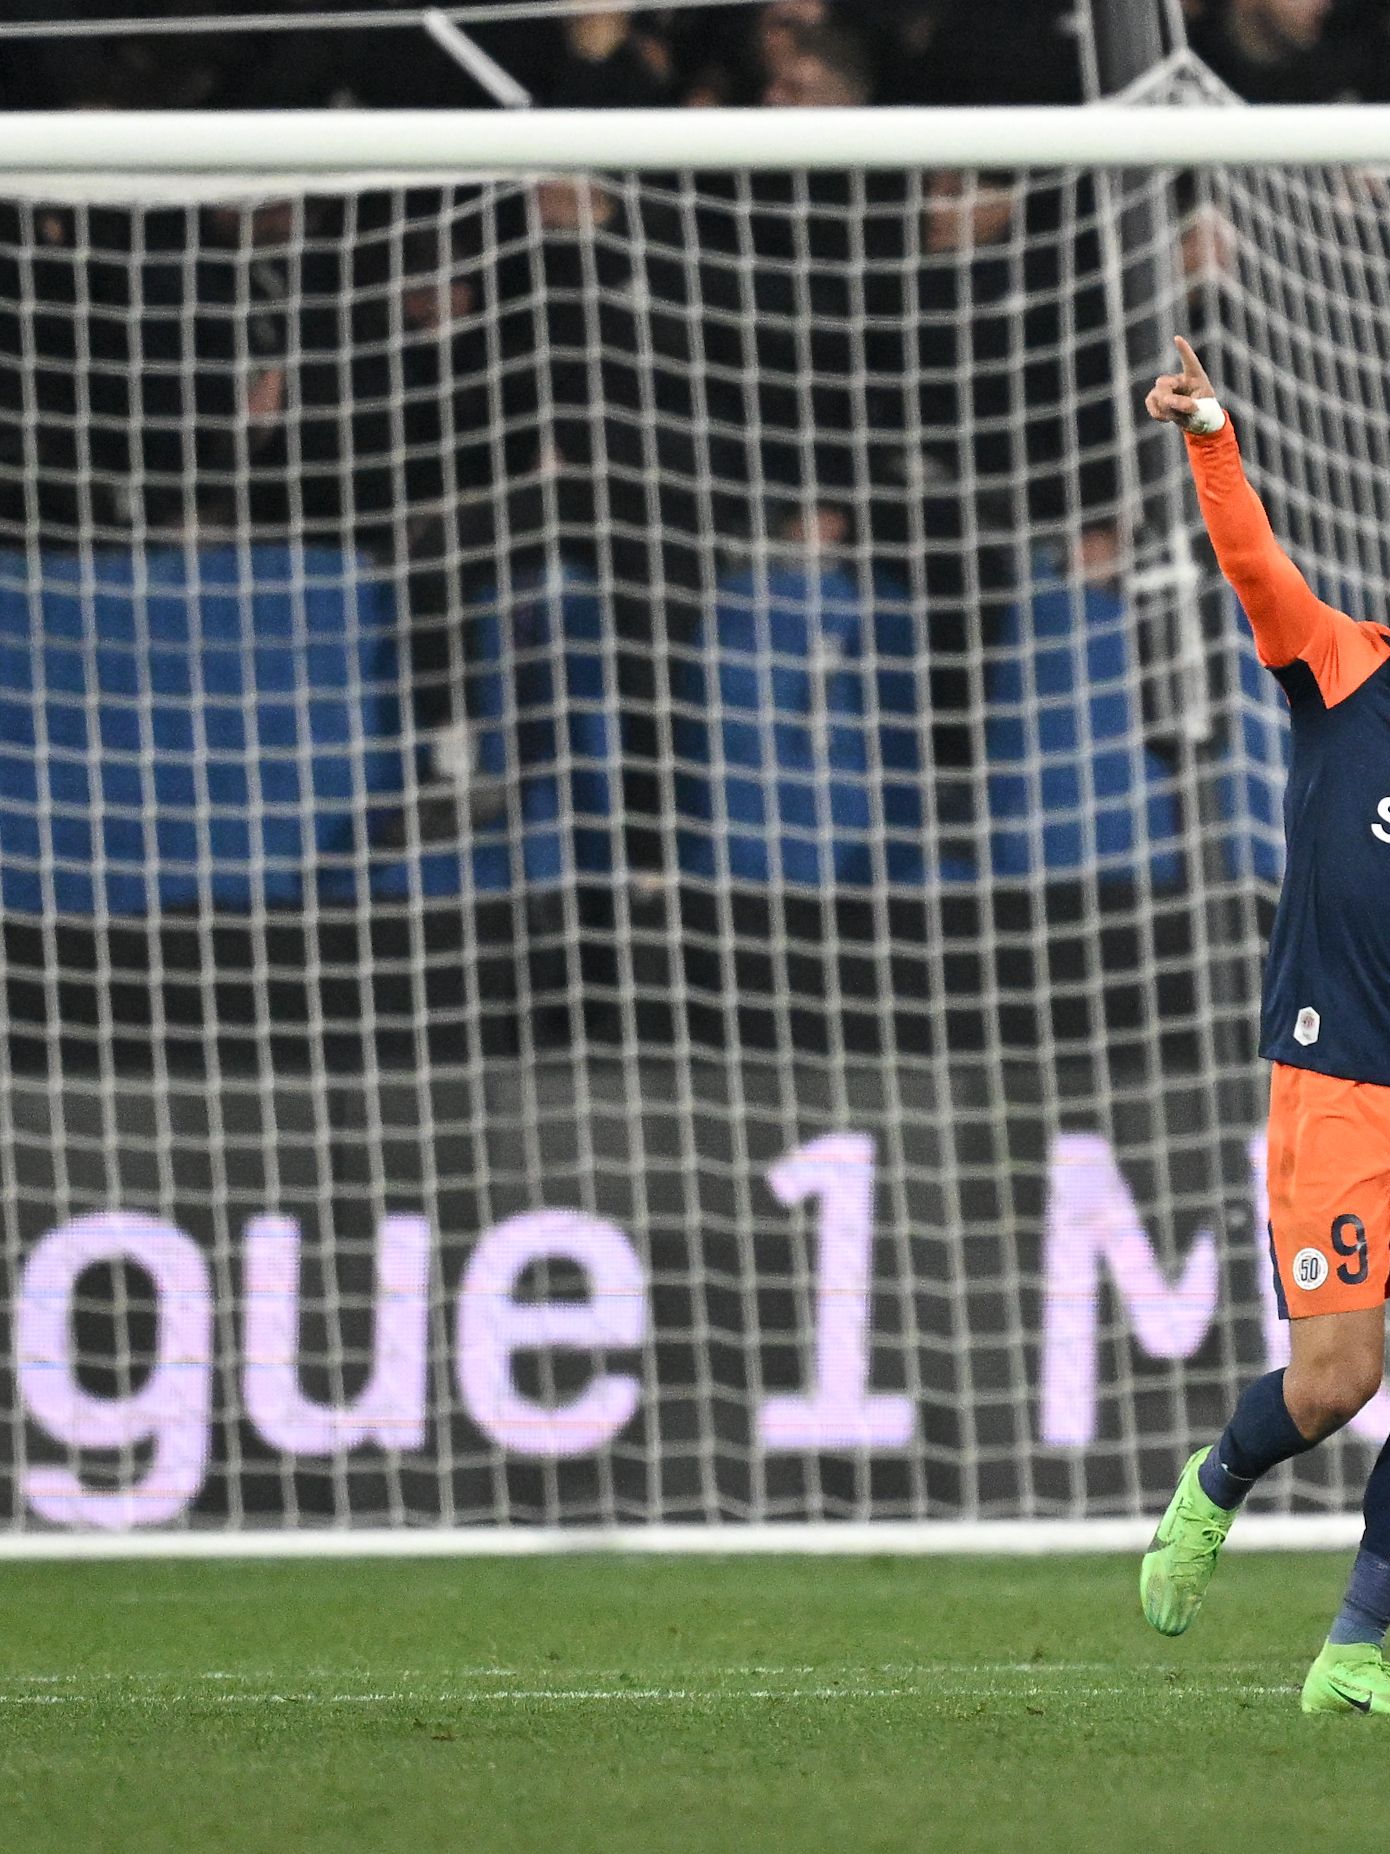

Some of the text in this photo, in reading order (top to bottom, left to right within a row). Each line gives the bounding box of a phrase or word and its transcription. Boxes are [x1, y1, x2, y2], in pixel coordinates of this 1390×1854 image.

[1300, 1257, 1319, 1281] 50
[1331, 1213, 1368, 1285] 9
[17, 1209, 646, 1526] gue
[757, 1130, 917, 1448] 1
